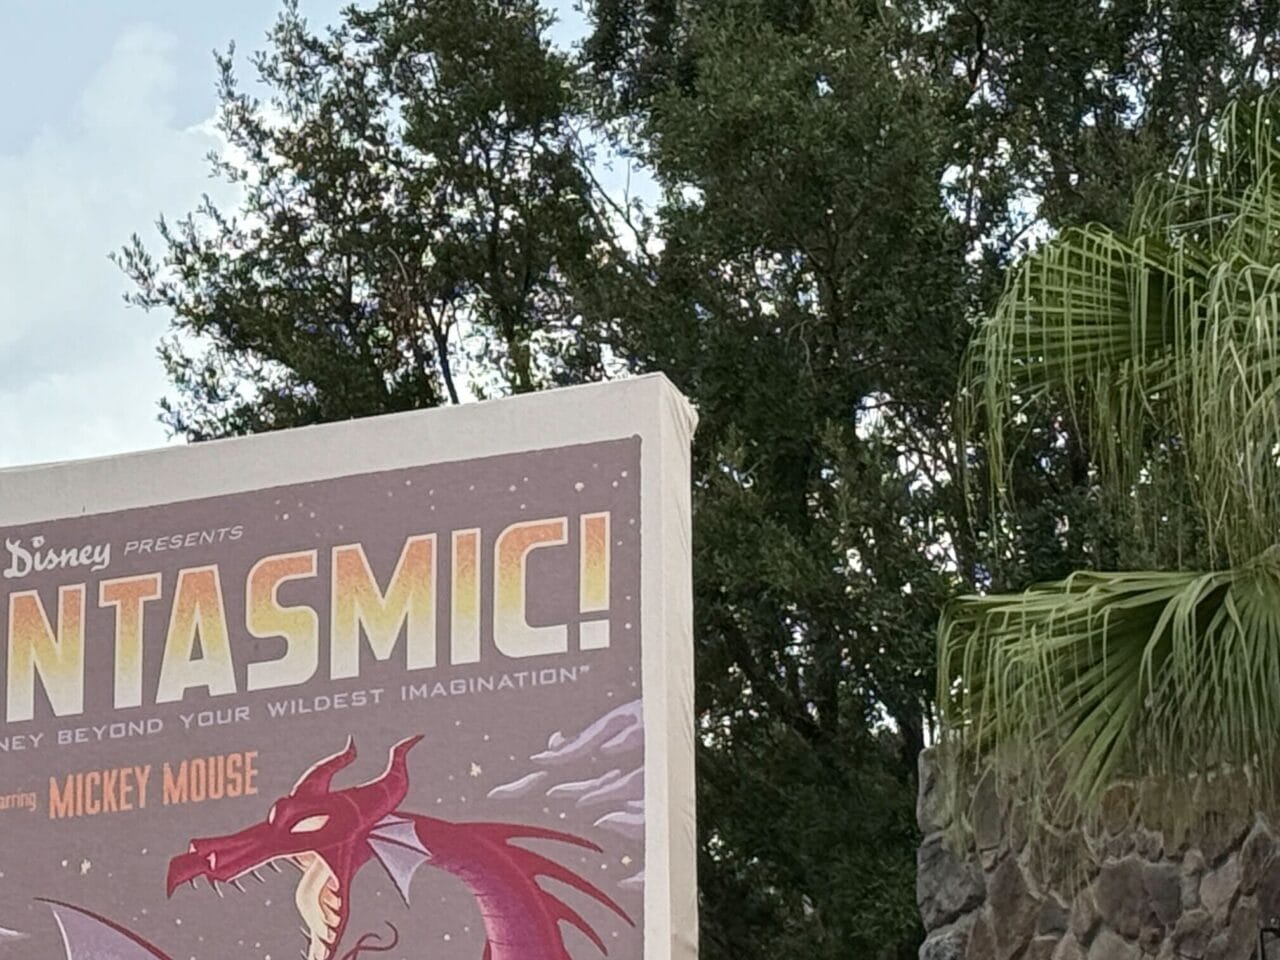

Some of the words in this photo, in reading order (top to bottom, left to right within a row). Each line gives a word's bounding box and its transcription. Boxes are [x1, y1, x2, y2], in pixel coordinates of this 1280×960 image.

[3, 535, 111, 579] Disney
[123, 525, 245, 556] PRESENTS
[57, 718, 164, 746] BEYOND
[179, 706, 251, 729] YOUR
[267, 688, 385, 718] WILDEST
[48, 764, 153, 820] MICKEY
[162, 750, 260, 806] MOUSE
